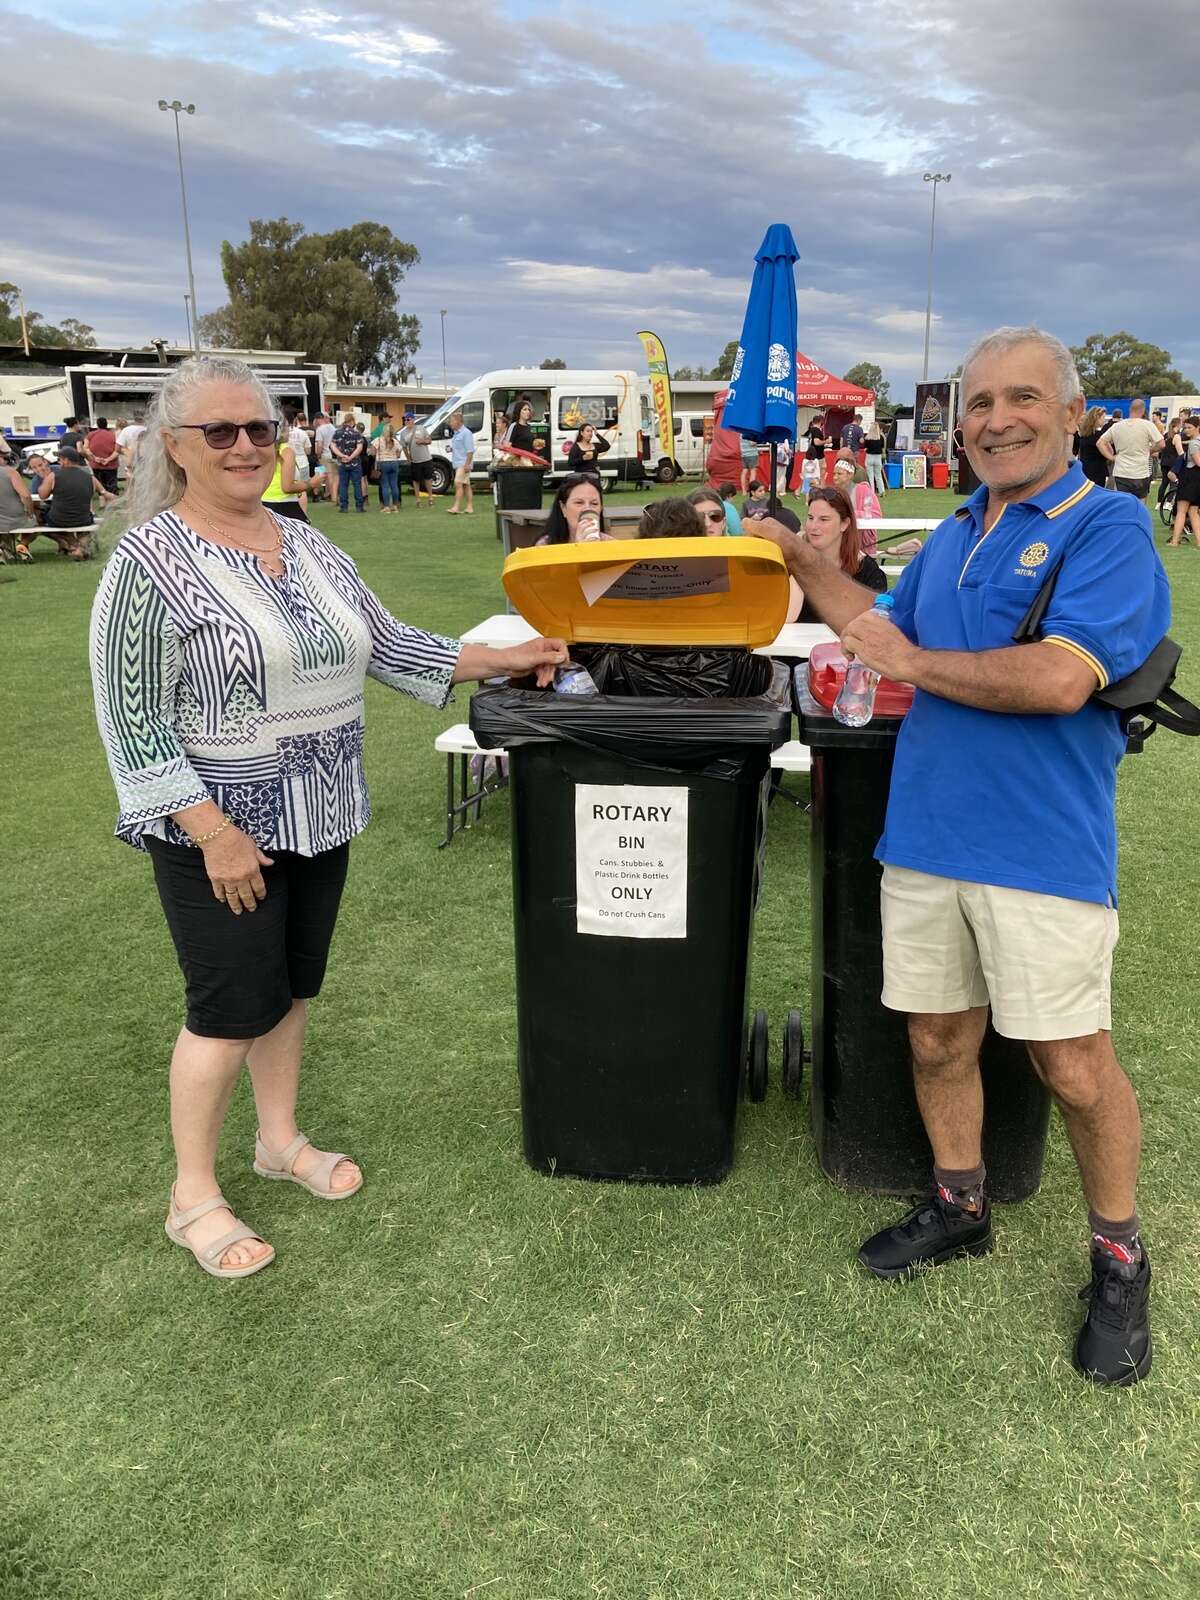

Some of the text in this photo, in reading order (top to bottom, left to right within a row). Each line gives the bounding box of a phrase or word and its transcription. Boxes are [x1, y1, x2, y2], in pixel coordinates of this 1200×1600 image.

[633, 563, 679, 572] OTARY
[592, 804, 672, 822] ROTARY
[618, 836, 645, 849] BIN
[594, 871, 669, 880] Plastic Drink Bottles
[611, 886, 653, 900] ONLY
[598, 909, 609, 917] Do
[625, 910, 646, 919] Crush
[648, 911, 666, 919] Cans
